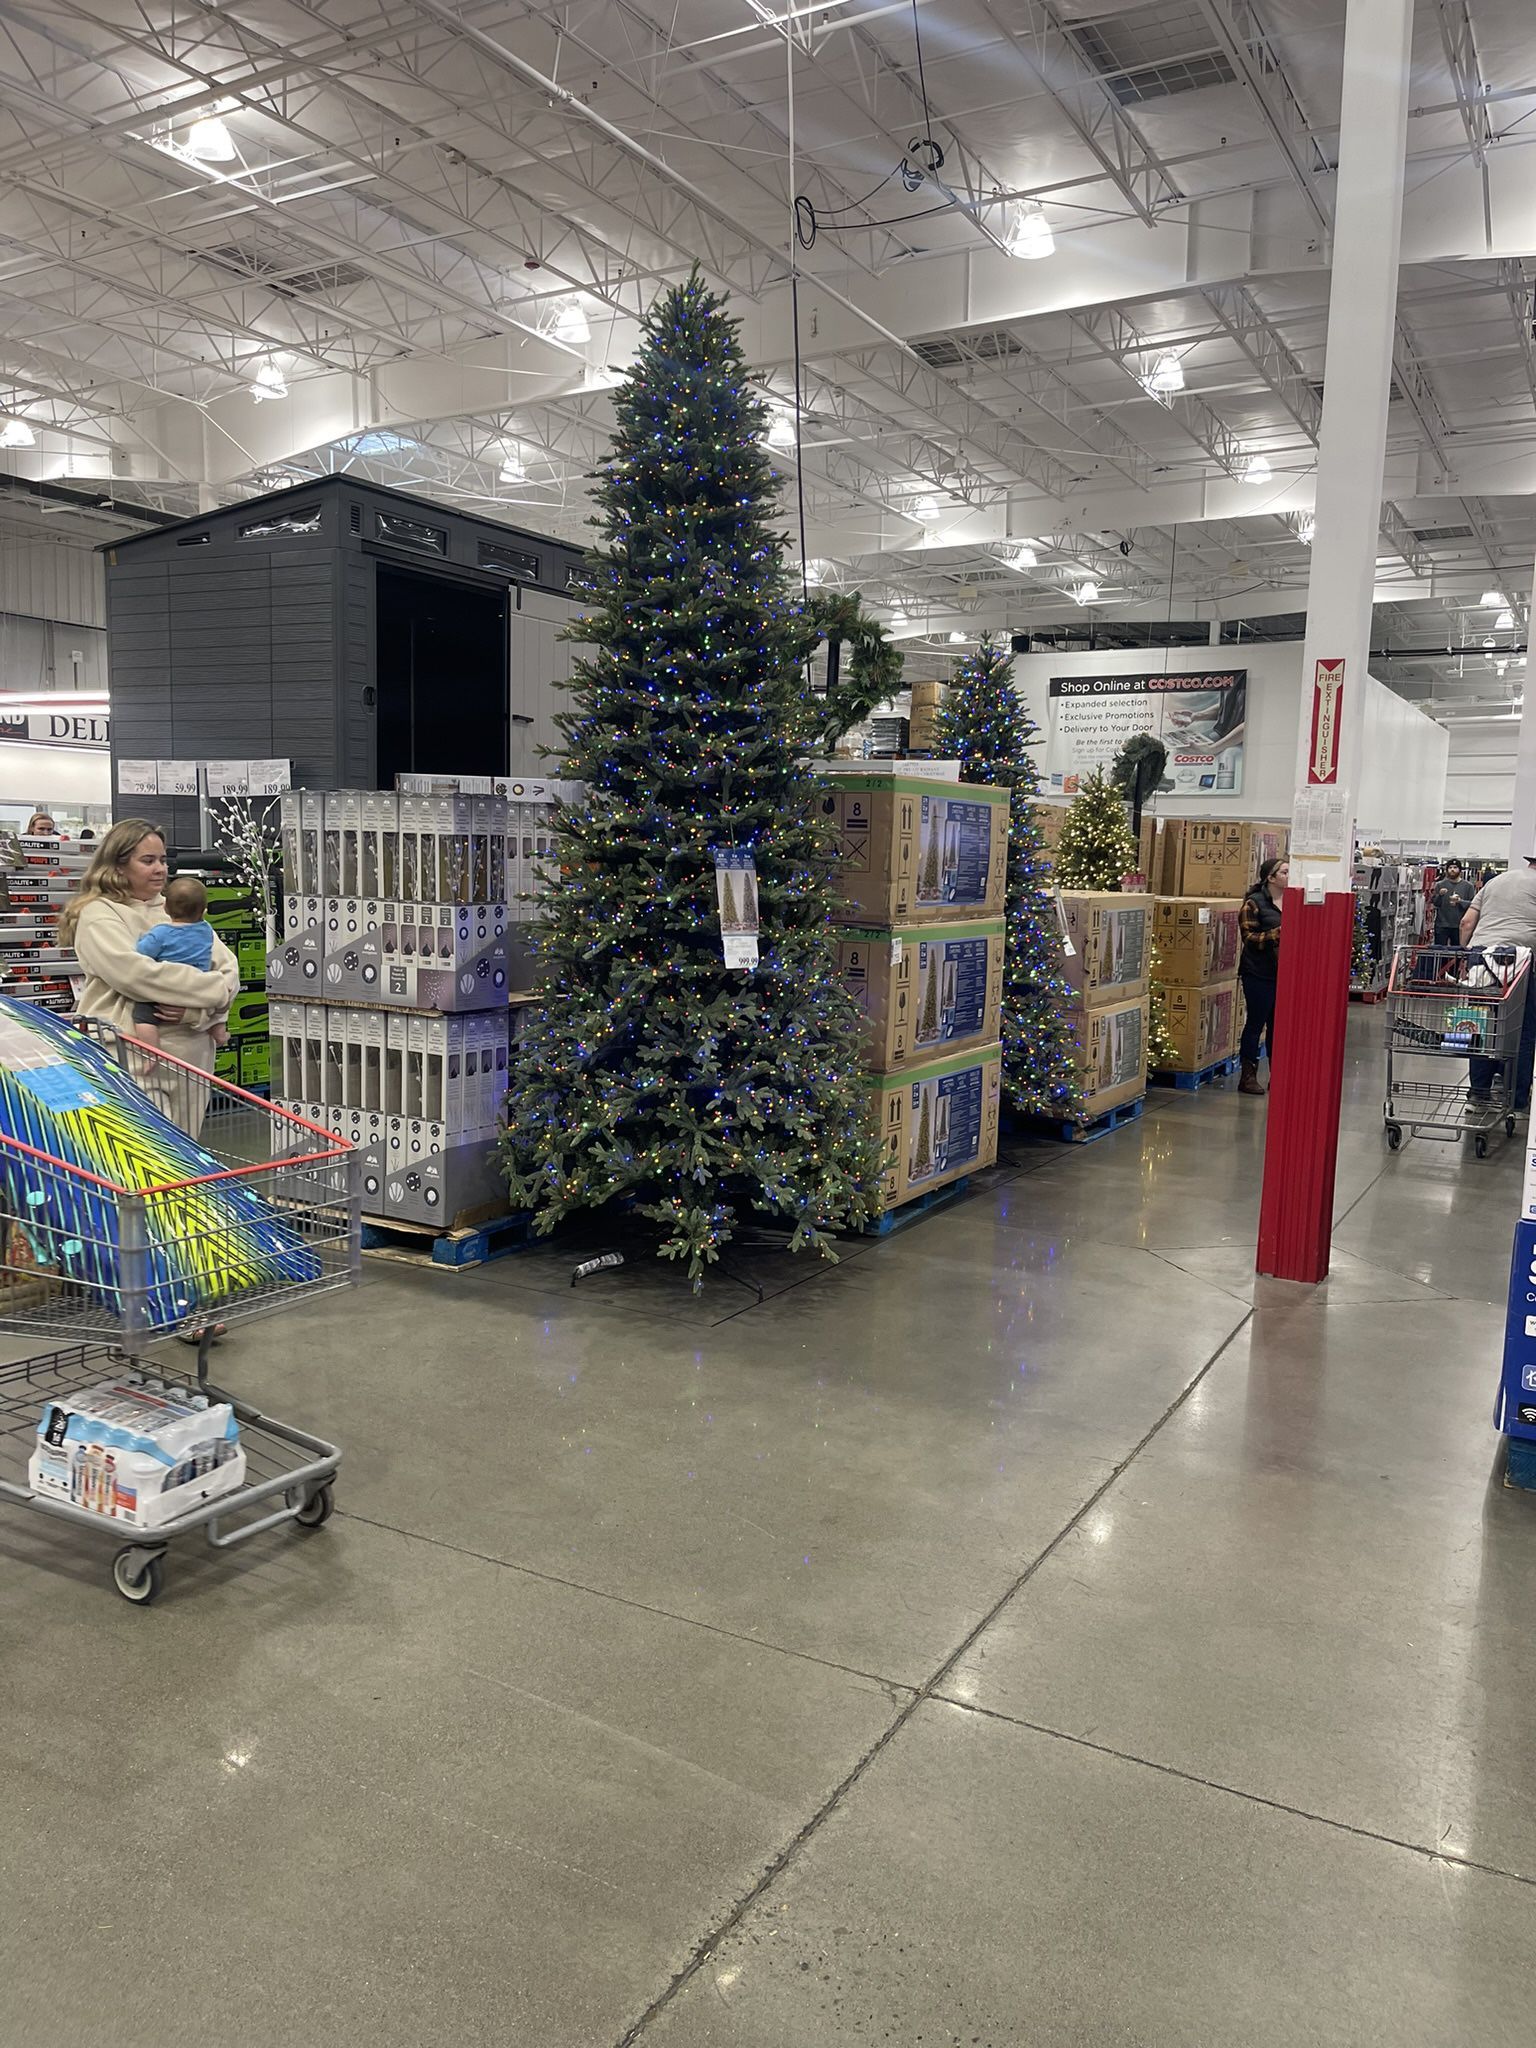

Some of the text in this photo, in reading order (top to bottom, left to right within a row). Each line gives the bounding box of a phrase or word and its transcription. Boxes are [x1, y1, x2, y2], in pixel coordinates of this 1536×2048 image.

[1319, 673, 1341, 682] FIRE
[1060, 676, 1235, 693] Shop Online at COSTCO.COM
[1064, 699, 1148, 709] Expanded selection
[1064, 711, 1154, 721] Exclusive Promotions
[1063, 723, 1153, 734] Delivery to Your Door
[1319, 683, 1333, 777] EXTINGUISHER
[1174, 754, 1214, 763] COSTCO
[135, 783, 156, 793] 79.99
[175, 783, 196, 793] 59.99
[222, 784, 248, 795] 189.99
[852, 802, 862, 816] 8
[1230, 828, 1236, 836] 8
[1183, 909, 1189, 918] 8
[850, 951, 859, 965] 8
[394, 982, 402, 993] 2
[1176, 995, 1183, 1004] 8
[889, 1176, 895, 1189] 8
